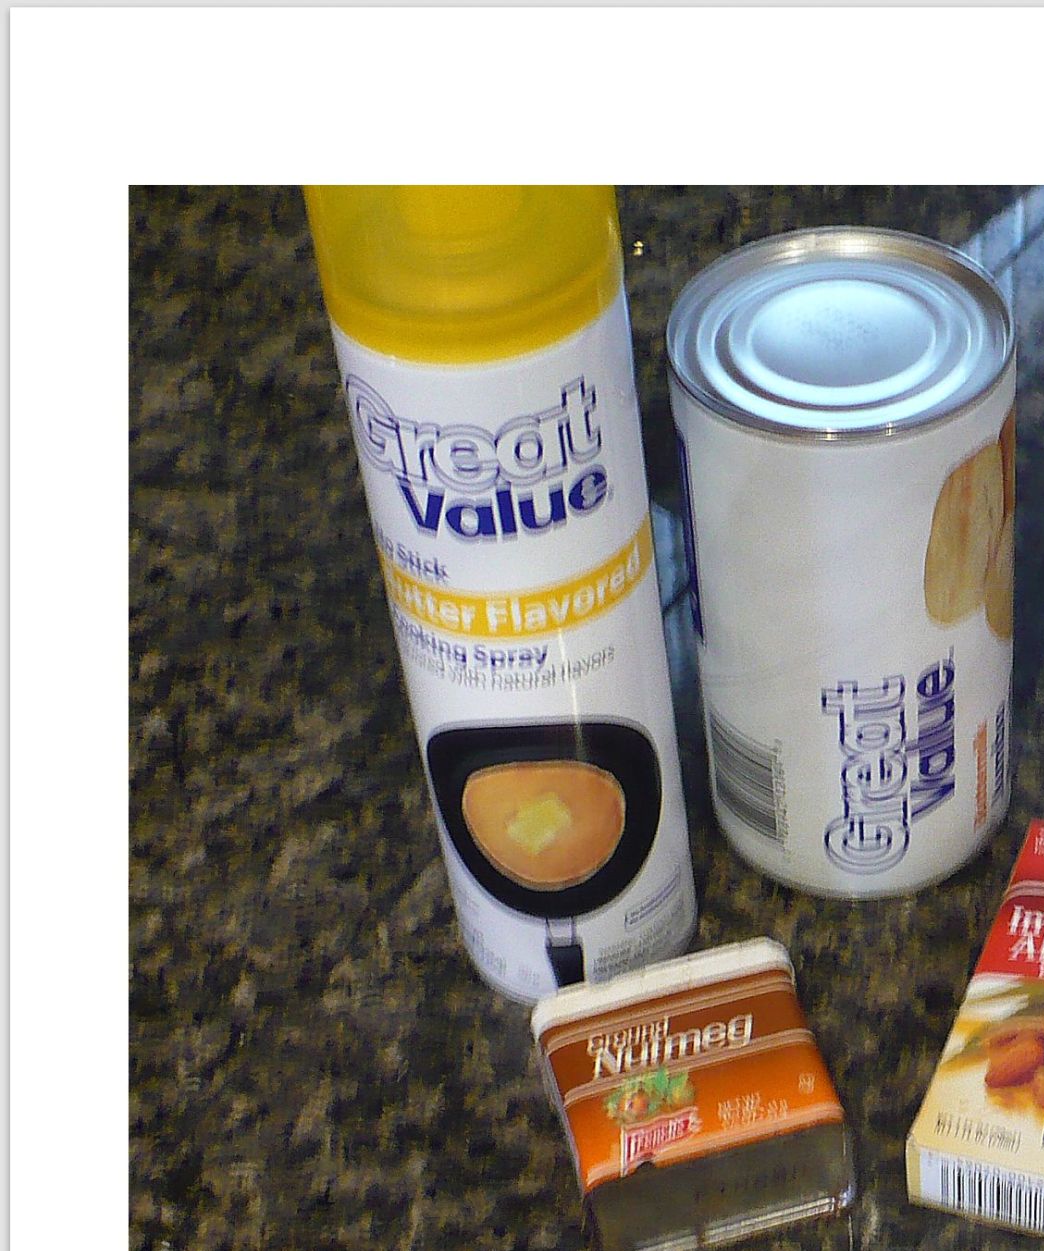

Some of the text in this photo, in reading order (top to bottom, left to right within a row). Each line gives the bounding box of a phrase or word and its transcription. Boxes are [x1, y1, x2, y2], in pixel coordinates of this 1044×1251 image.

[345, 373, 602, 494] Great
[395, 464, 612, 541] Value
[396, 542, 450, 587] Stick
[485, 540, 643, 635] Flavored
[473, 641, 549, 673] Spray
[821, 674, 911, 876] Great
[908, 657, 957, 824] Value
[592, 1012, 755, 1080] Nutmeg
